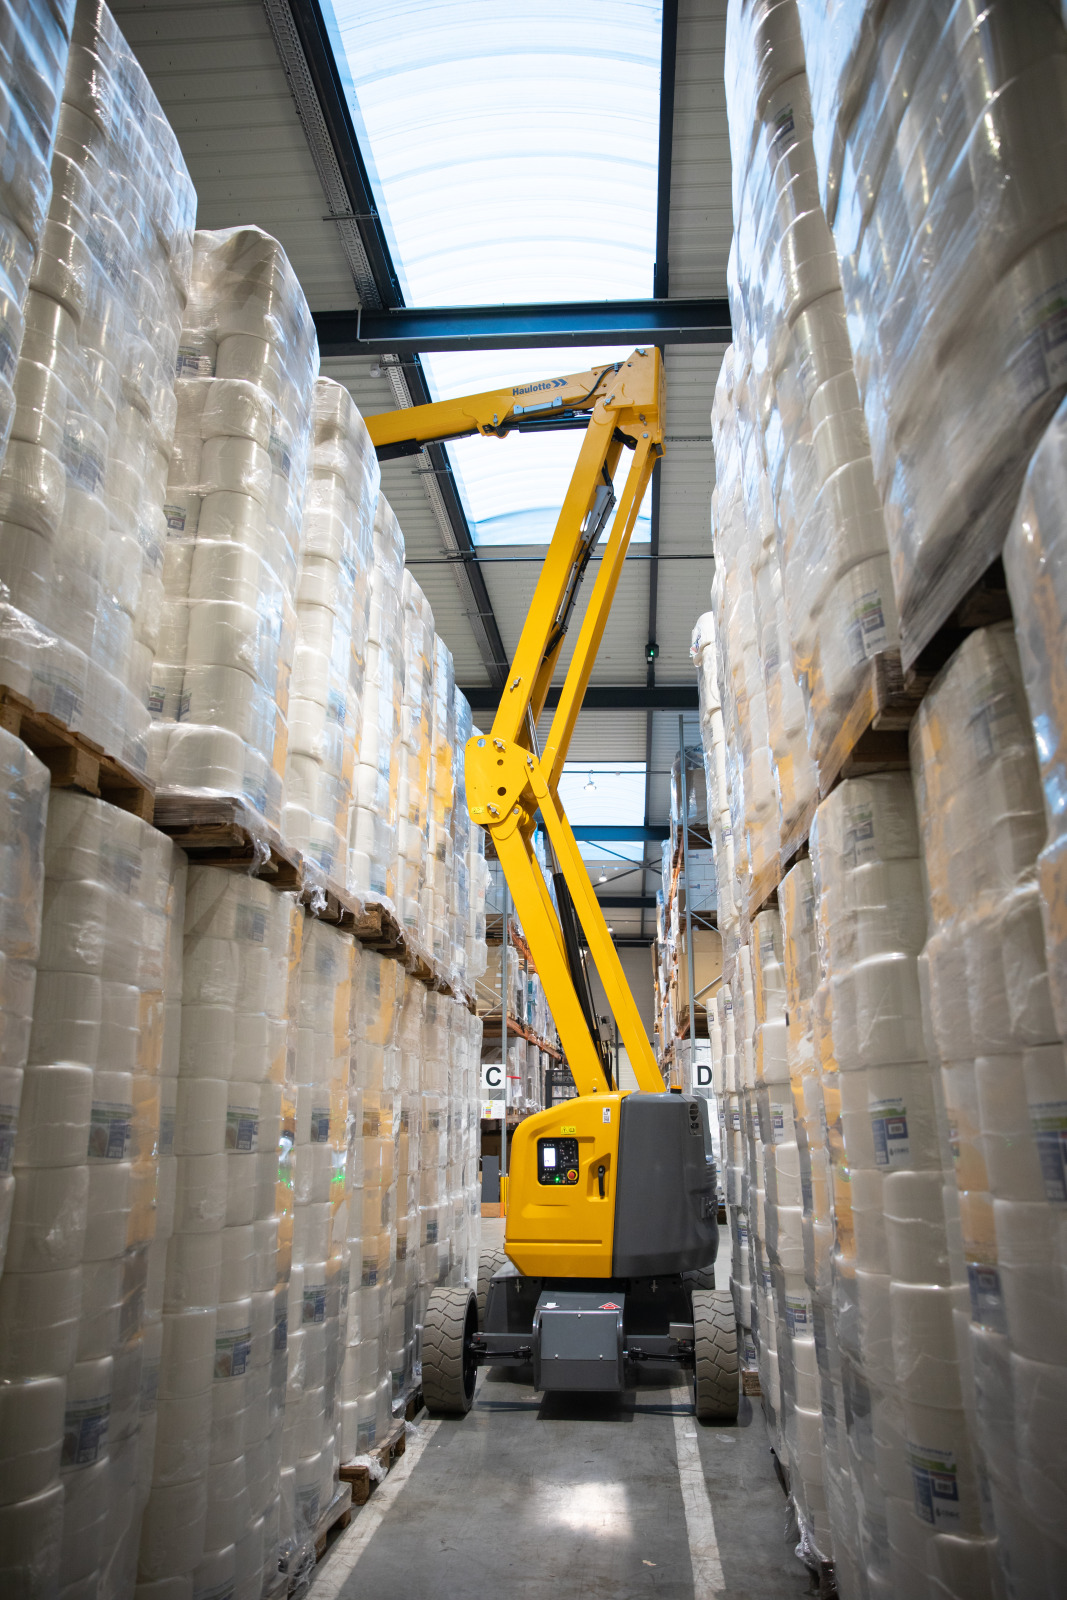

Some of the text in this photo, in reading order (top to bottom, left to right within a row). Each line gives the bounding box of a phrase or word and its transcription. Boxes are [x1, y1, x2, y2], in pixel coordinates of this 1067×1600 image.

[513, 382, 551, 396] Haulotte
[485, 1066, 502, 1087] C
[697, 1065, 713, 1086] D
